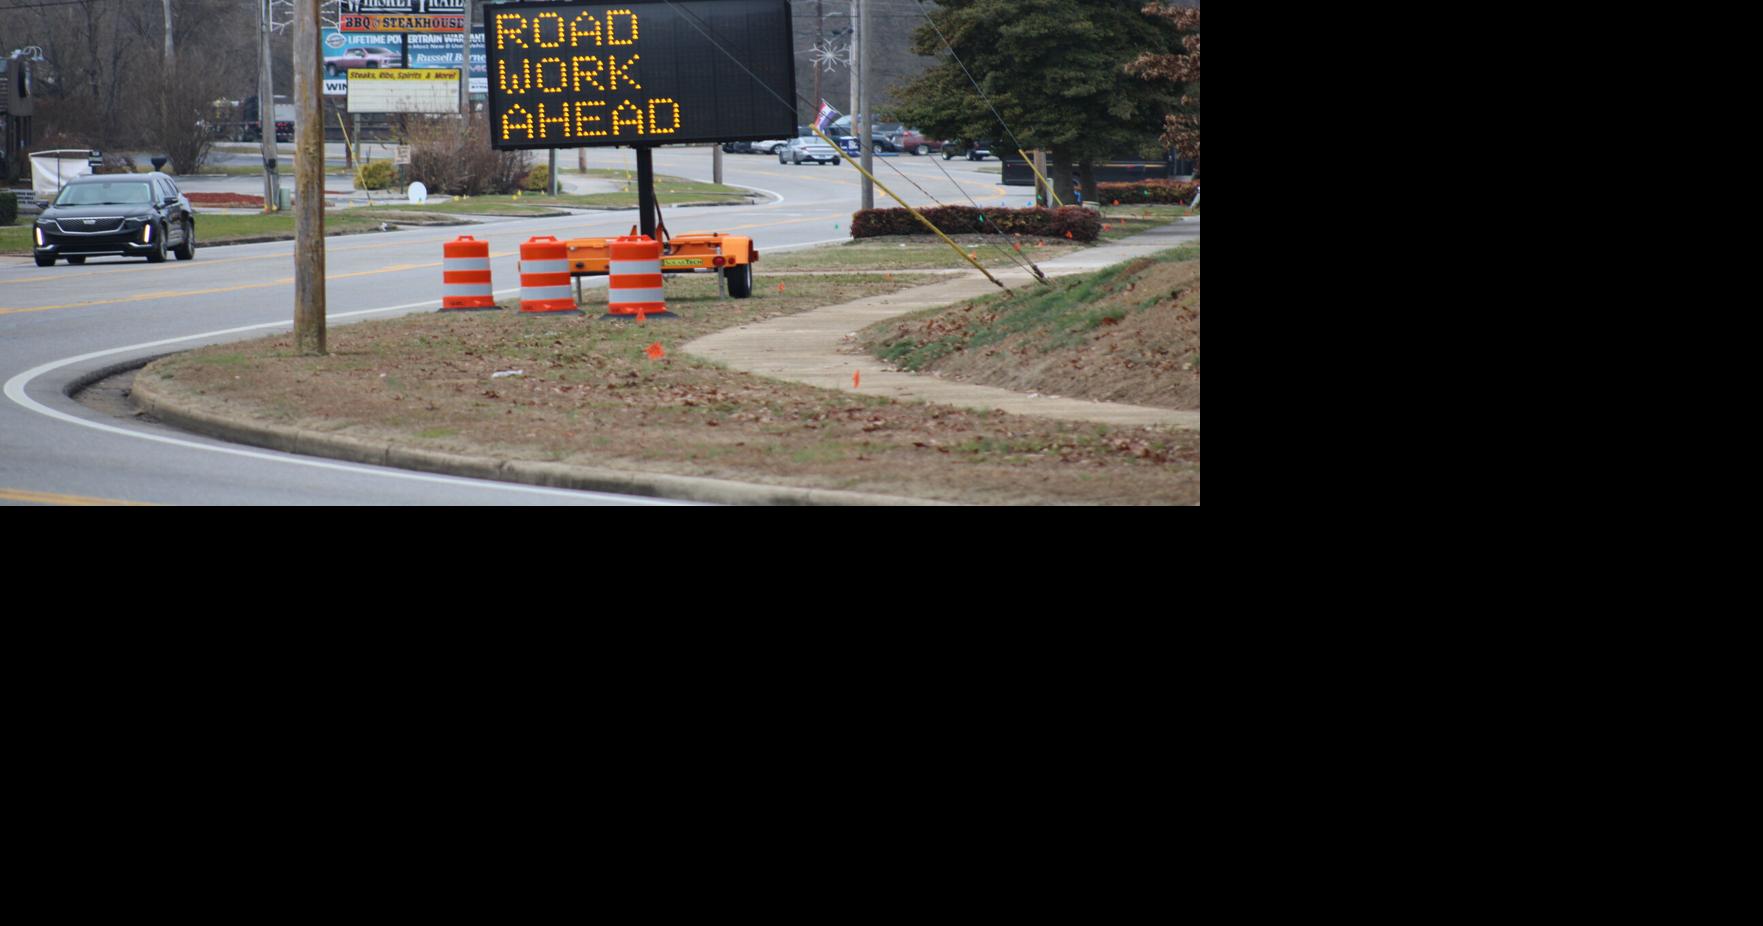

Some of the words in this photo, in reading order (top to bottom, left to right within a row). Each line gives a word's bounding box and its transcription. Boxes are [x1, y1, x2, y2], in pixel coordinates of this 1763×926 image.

[345, 17, 370, 30] BBQ
[383, 17, 464, 28] STEAKHOUSE
[496, 9, 639, 50] ROAD
[348, 35, 386, 44] LIFETIME
[416, 52, 453, 63] Russell
[397, 71, 421, 80] Spirits
[498, 54, 642, 95] WORK
[502, 98, 680, 140] AHEAD
